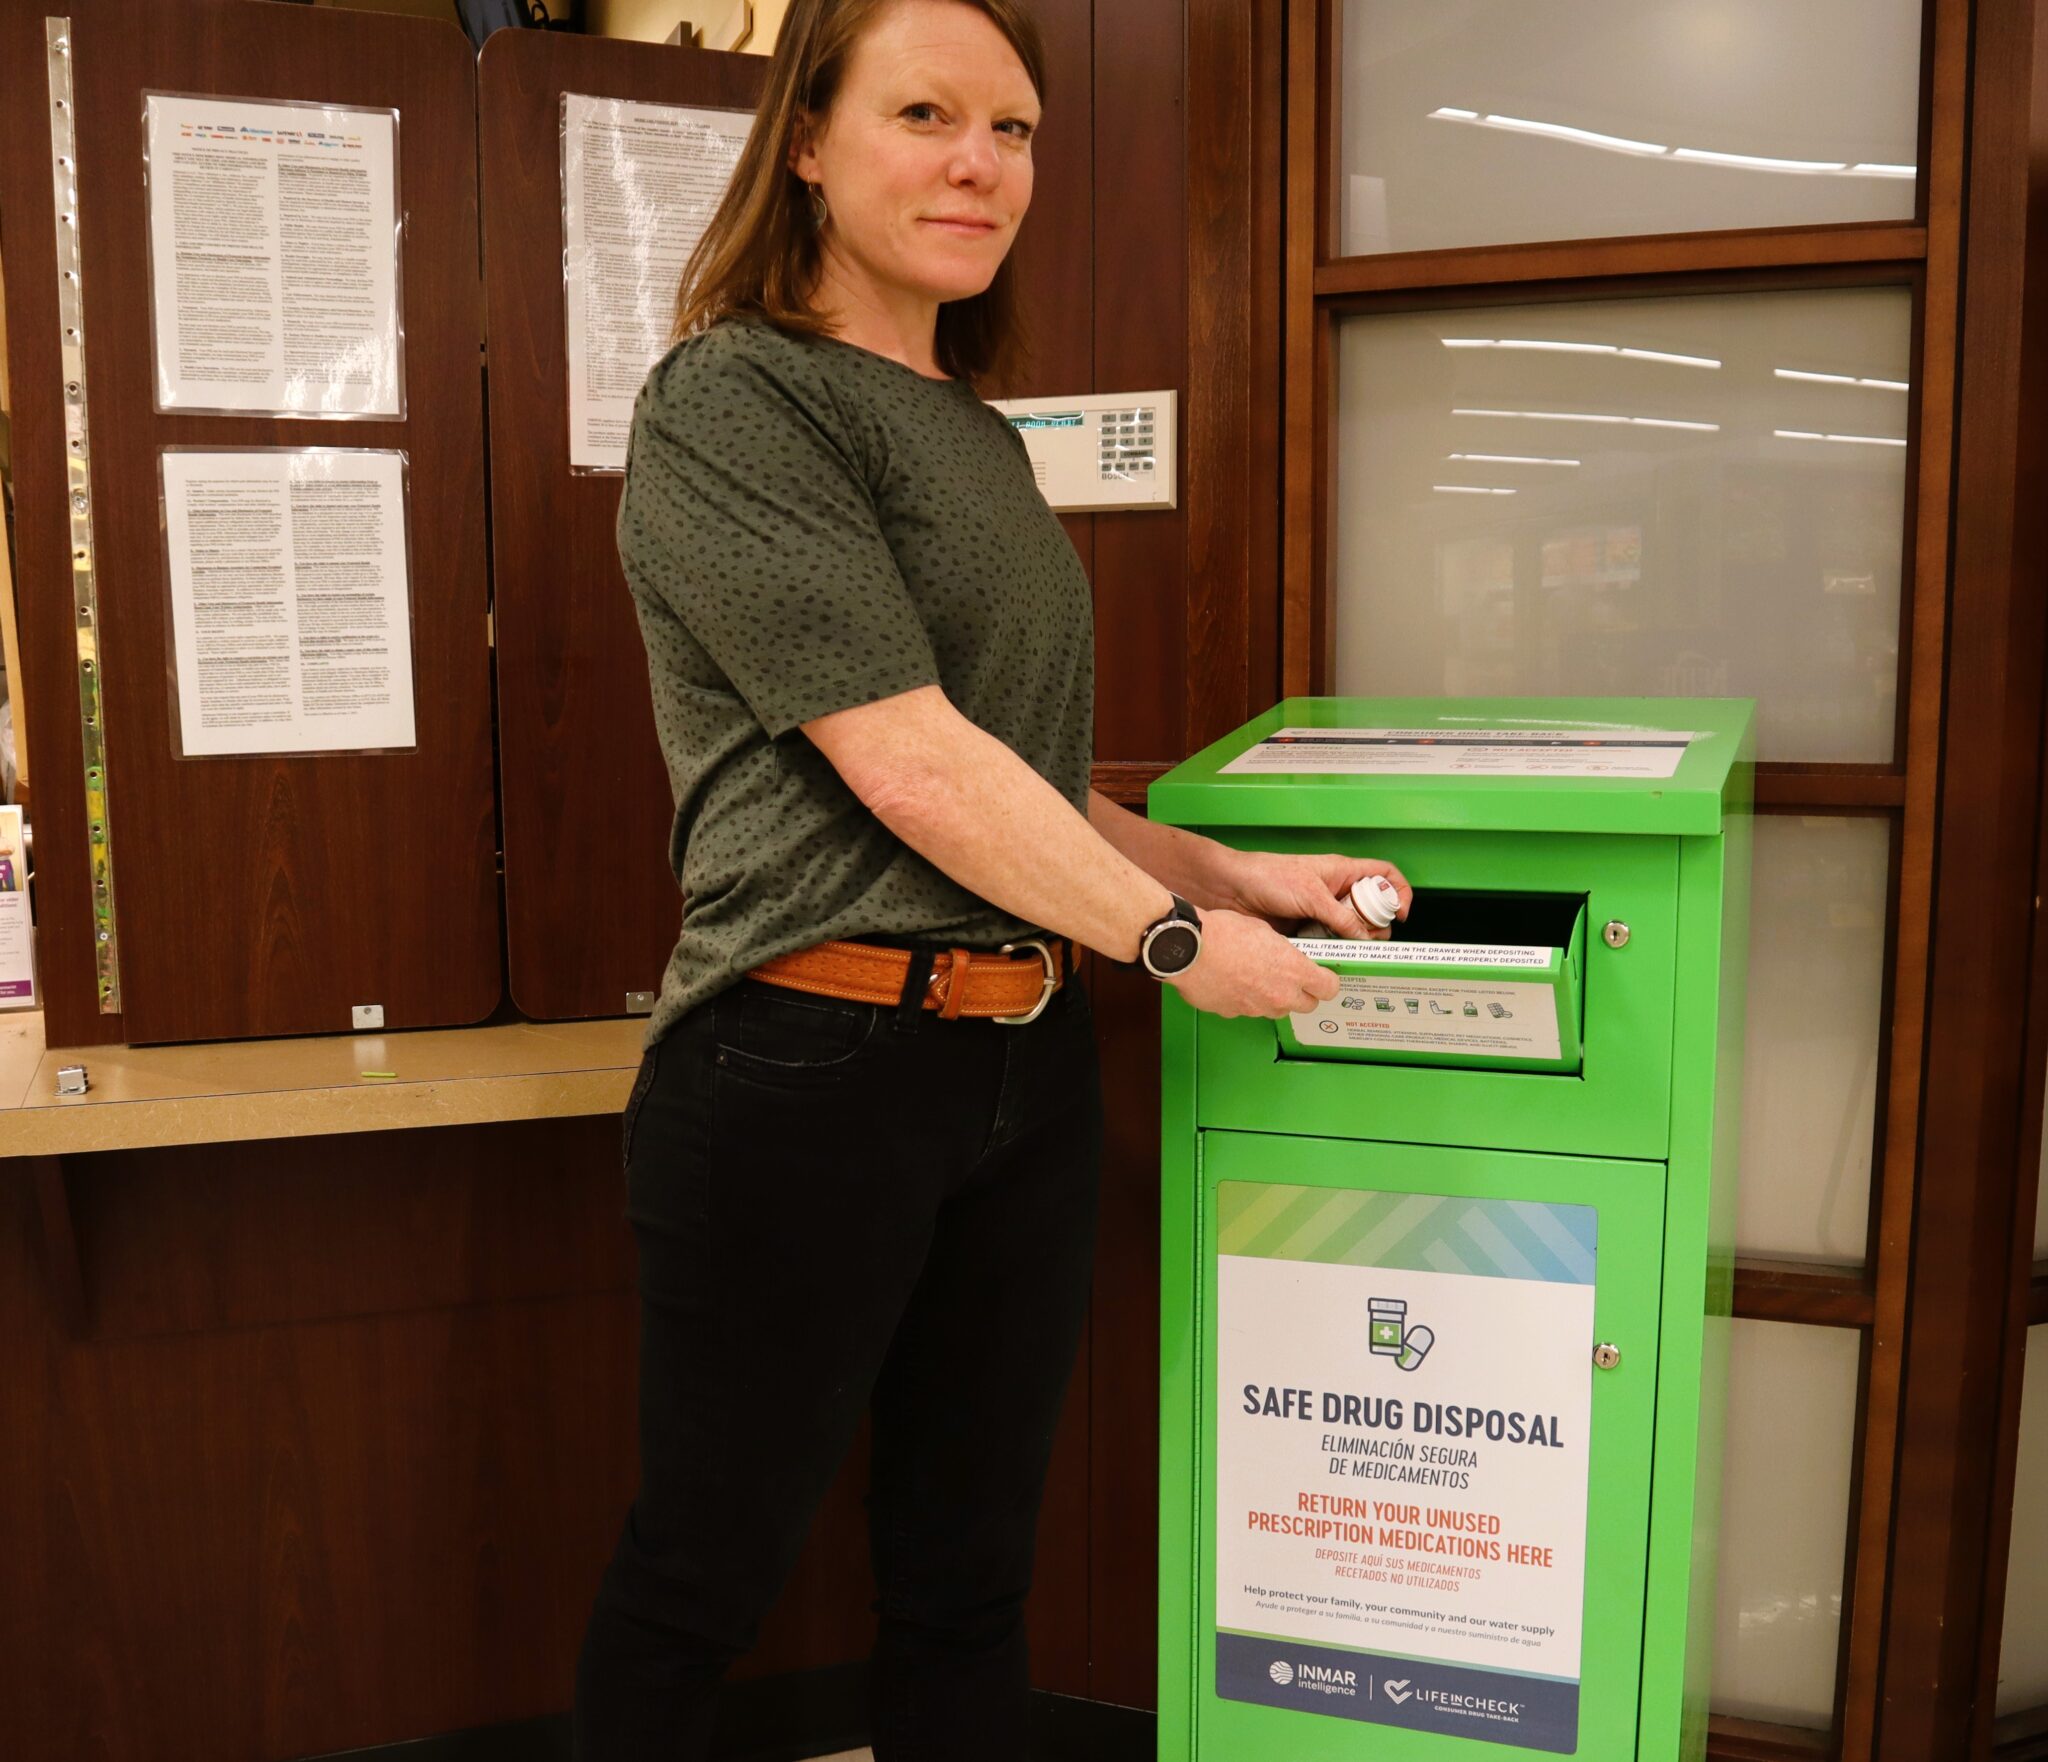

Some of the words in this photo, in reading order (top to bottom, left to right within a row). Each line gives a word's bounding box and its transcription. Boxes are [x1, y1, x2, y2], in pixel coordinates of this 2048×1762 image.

[1243, 1384, 1312, 1420] SAFE
[1323, 1392, 1403, 1430] DRUG
[1414, 1402, 1564, 1448] DISPOSAL
[1321, 1434, 1415, 1461] ELIMINACIÓN
[1419, 1445, 1478, 1468] SEGURA
[1329, 1457, 1348, 1475] DE
[1352, 1459, 1470, 1490] MEDICAMENTOS
[1298, 1492, 1367, 1519] RETURN
[1372, 1501, 1421, 1526] YOUR
[1426, 1508, 1500, 1535] UNUSED
[1248, 1511, 1374, 1545] PRESCRIPTION
[1379, 1528, 1501, 1561] MEDICATIONS
[1507, 1544, 1553, 1568] HERE
[1315, 1548, 1358, 1564] DEPOSITE
[1361, 1554, 1384, 1566] AQUÍ
[1385, 1557, 1404, 1569] SUS
[1407, 1560, 1482, 1580] MEDICAMENTOS
[1335, 1565, 1388, 1582] RECETADOS
[1390, 1573, 1403, 1584] NO
[1406, 1576, 1460, 1592] UTILIZADOS
[1244, 1585, 1267, 1597] Help
[1269, 1589, 1304, 1601] protect
[1306, 1594, 1328, 1604] your
[1330, 1597, 1363, 1610] family,
[1365, 1602, 1387, 1612] your
[1389, 1606, 1446, 1622] community
[1448, 1615, 1467, 1624] and
[1469, 1617, 1487, 1626] our
[1489, 1620, 1518, 1631] water
[1520, 1624, 1555, 1637] supply
[1255, 1600, 1279, 1611] Ayude
[1286, 1605, 1317, 1616] proteger
[1325, 1610, 1334, 1618] su
[1335, 1611, 1362, 1623] familia,
[1371, 1617, 1380, 1625] su
[1381, 1618, 1423, 1631] comunidad
[1424, 1624, 1429, 1632] y
[1438, 1626, 1467, 1637] nuestro
[1468, 1631, 1508, 1642] suministro
[1510, 1635, 1520, 1644] de
[1522, 1639, 1542, 1648] agua
[1298, 1663, 1357, 1687] INMAR
[1298, 1679, 1356, 1696] intelligence
[1434, 1705, 1468, 1715] CONSUMER
[1468, 1710, 1486, 1718] DRUG
[1486, 1713, 1519, 1723] TAKE-BACK
